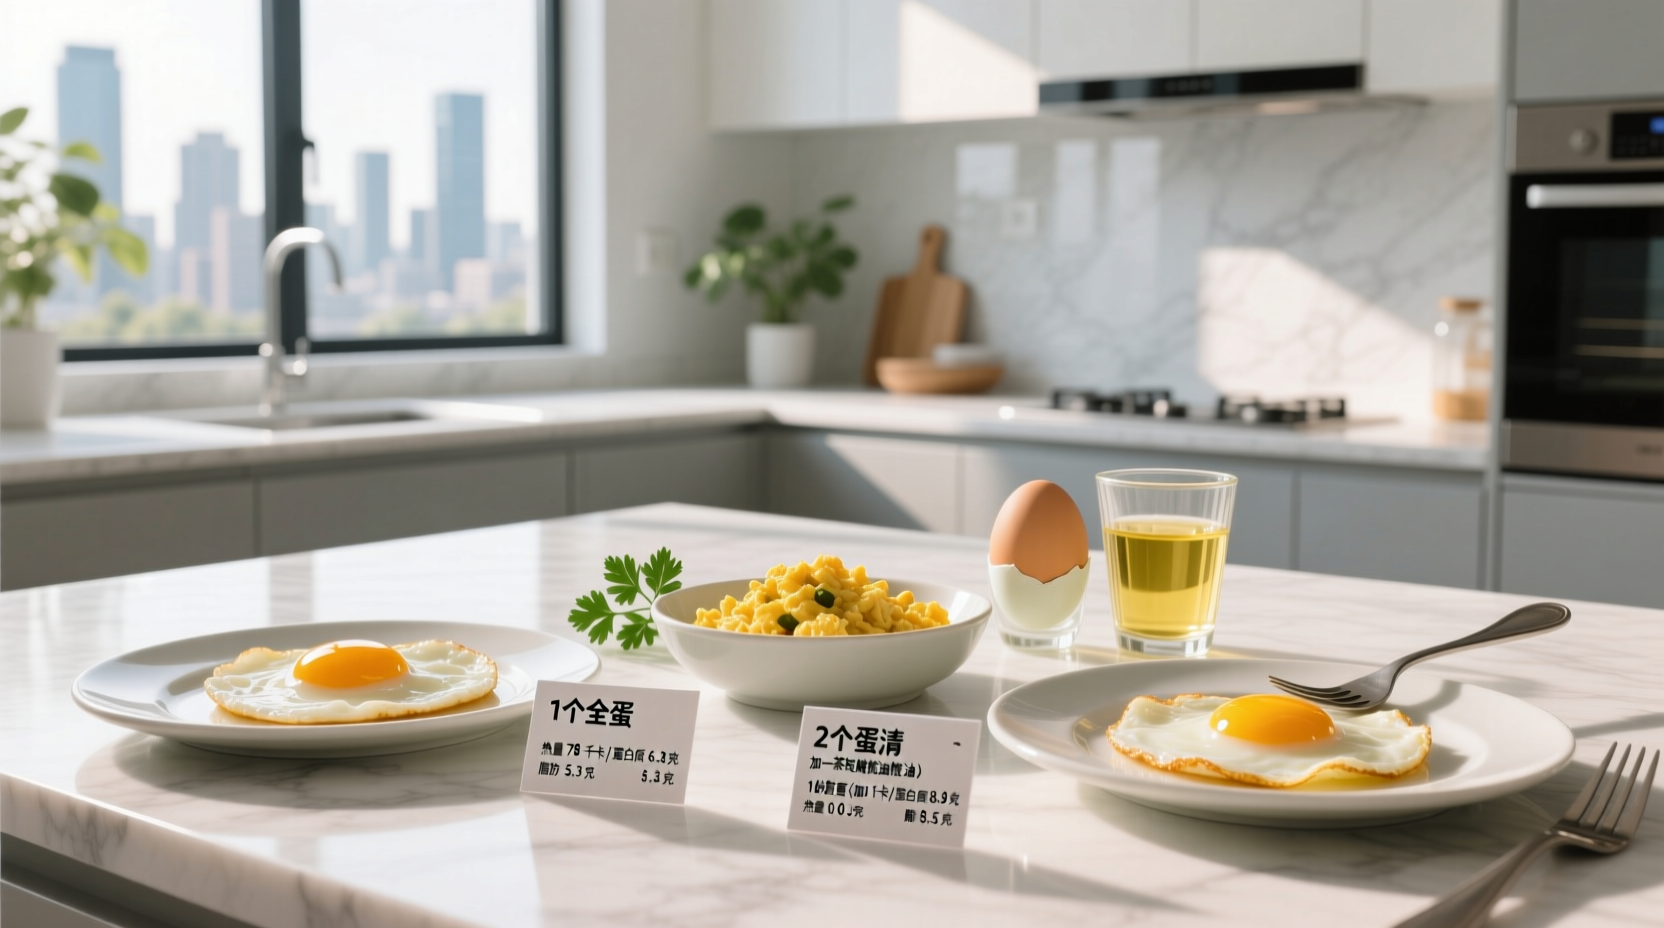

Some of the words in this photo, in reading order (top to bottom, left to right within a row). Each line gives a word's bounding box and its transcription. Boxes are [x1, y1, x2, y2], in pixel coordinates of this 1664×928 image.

[550, 697, 635, 729] 1个全蛋
[813, 724, 905, 757] 2个蛋清
